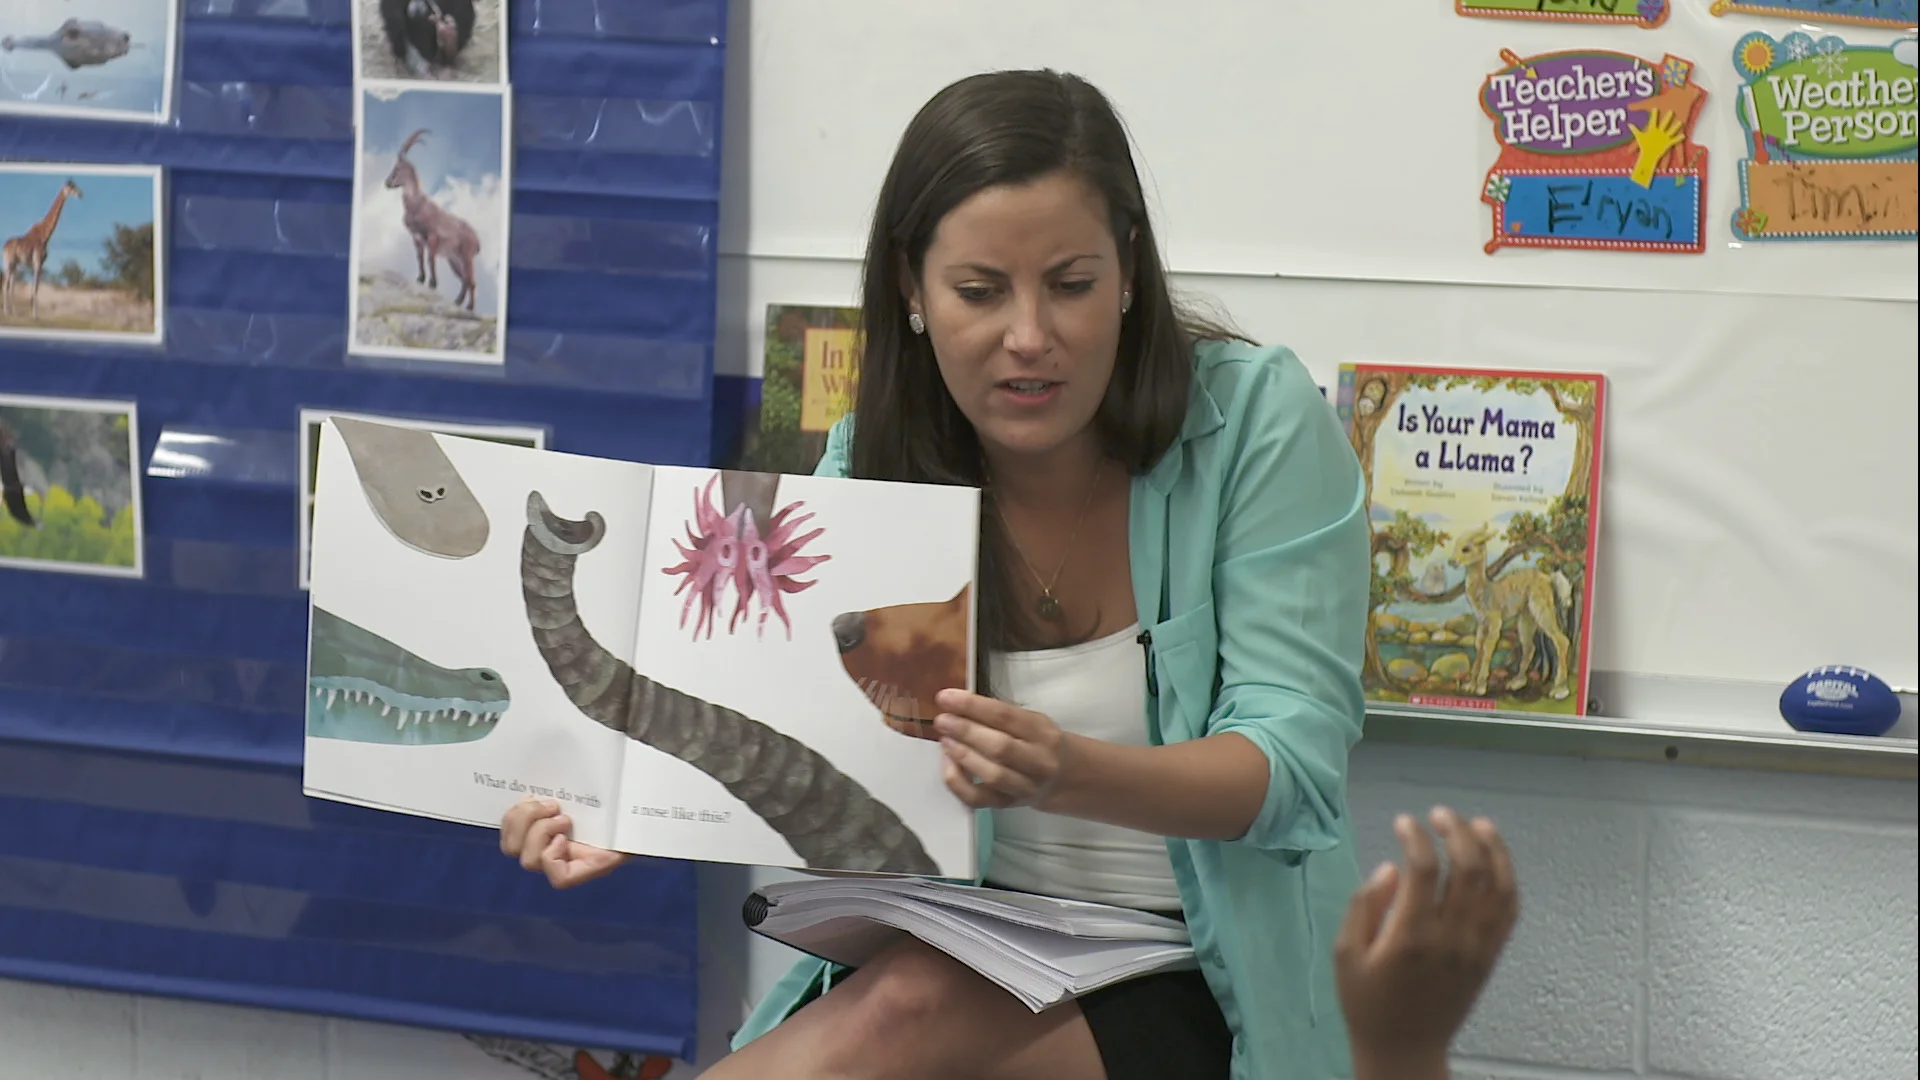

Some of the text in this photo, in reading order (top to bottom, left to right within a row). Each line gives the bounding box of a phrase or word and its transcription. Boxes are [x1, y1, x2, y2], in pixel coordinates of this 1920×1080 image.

[1490, 58, 1655, 109] Teacher's
[1767, 68, 1918, 111] Weathe
[1503, 103, 1627, 149] Helper
[821, 339, 844, 370] In
[1397, 402, 1556, 439] Is Your Mama
[1415, 440, 1534, 475] a Llama?
[473, 771, 507, 790] What
[508, 779, 527, 793] do
[555, 787, 573, 802] do
[574, 792, 602, 809] with
